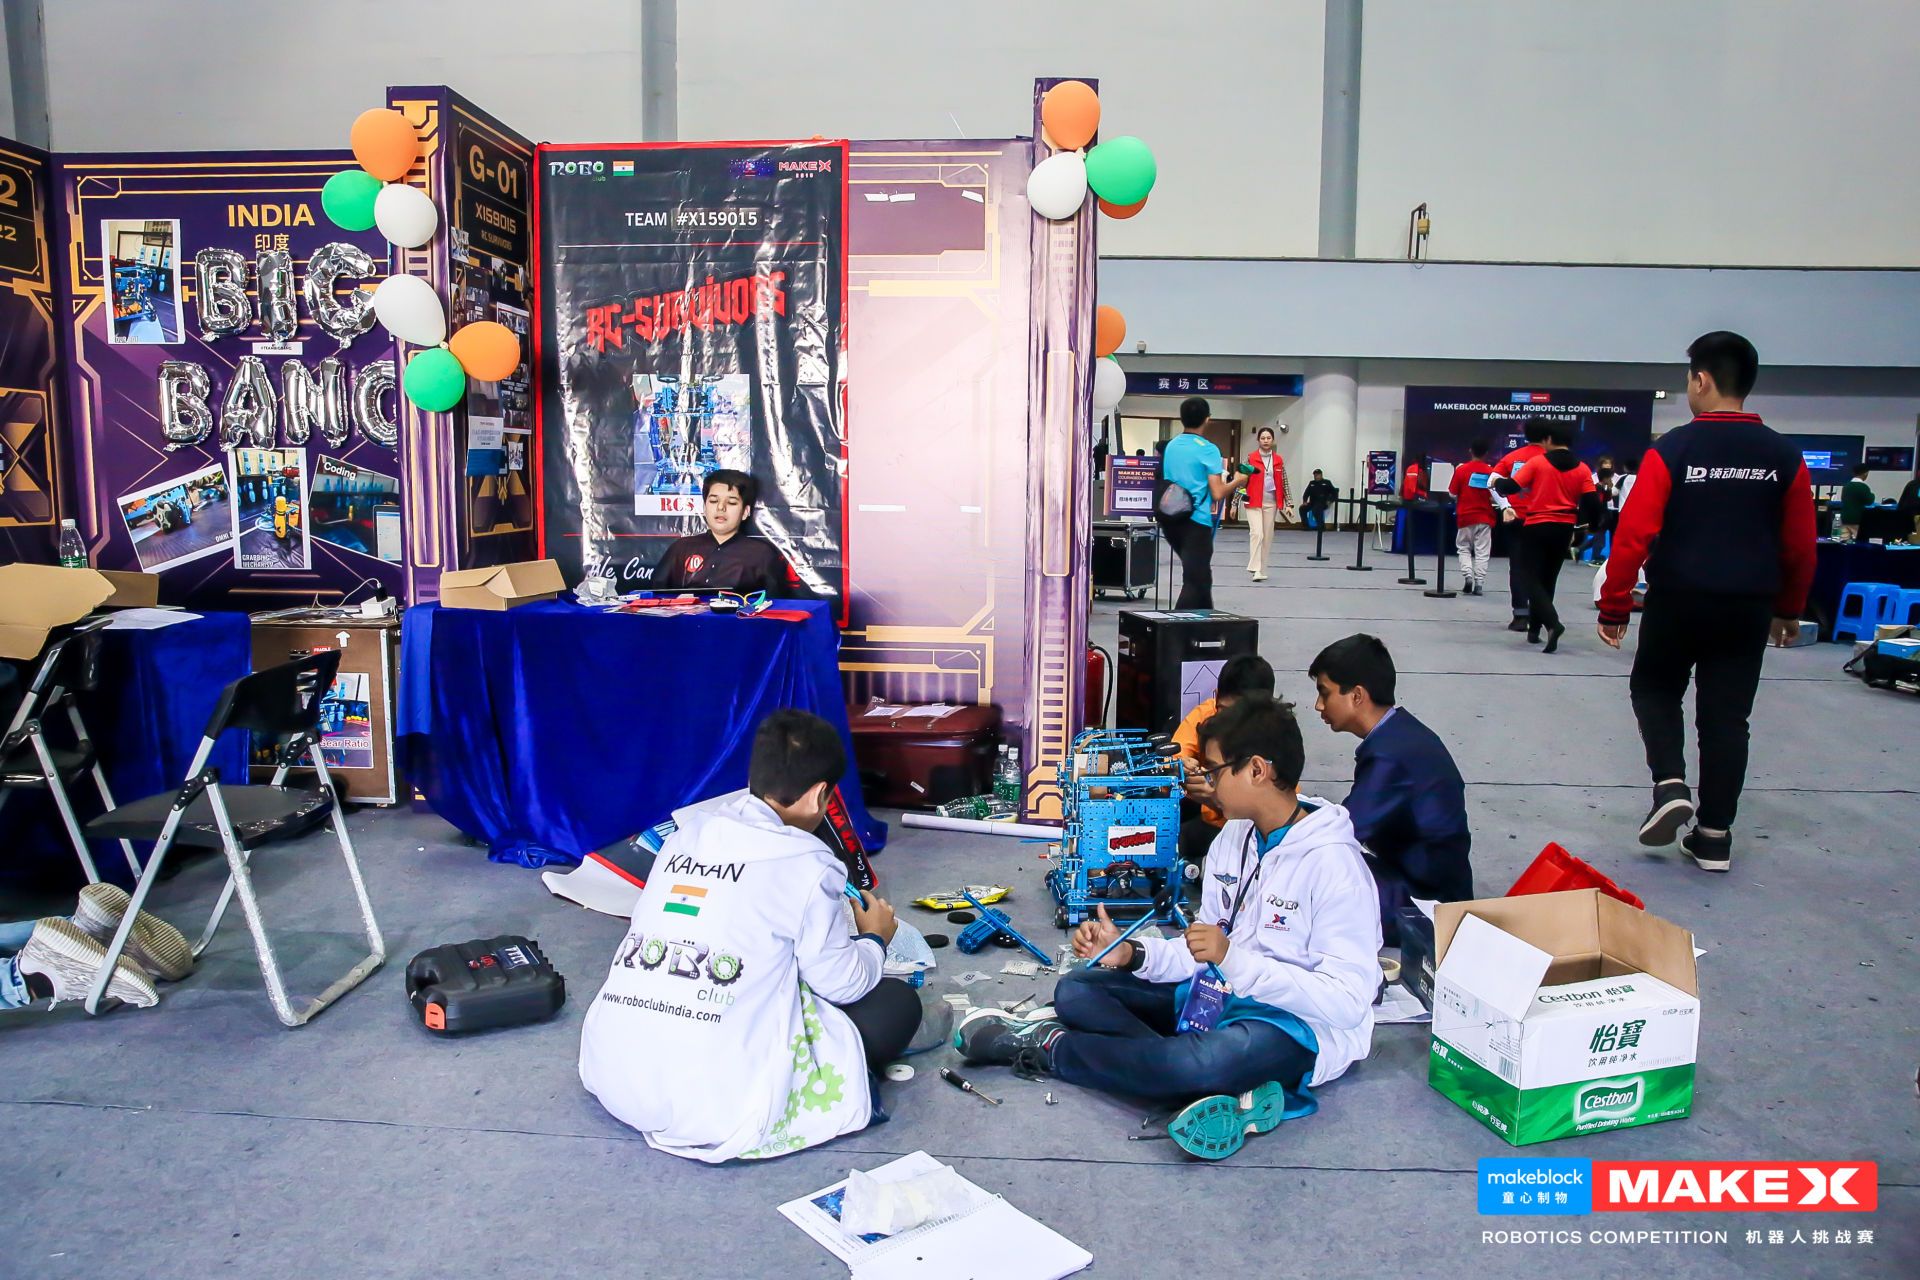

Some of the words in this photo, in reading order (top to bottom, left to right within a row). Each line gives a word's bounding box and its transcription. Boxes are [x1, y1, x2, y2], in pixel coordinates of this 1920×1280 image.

[468, 144, 518, 200] G-01
[548, 160, 605, 176] ROBO
[227, 203, 316, 228] INDIA
[625, 211, 668, 227] TEAM
[676, 211, 758, 226] #X159015
[254, 233, 290, 252] 印度
[194, 241, 378, 348] BIG
[1158, 378, 1209, 390] 赛场区
[1434, 402, 1488, 411] MAKEBLOCK
[1489, 403, 1521, 412] MAKEX
[1523, 404, 1566, 412] ROBOTICS
[1567, 405, 1627, 413] COMPETITION
[323, 460, 357, 481] Coding
[1709, 467, 1778, 482] 领动机器人
[623, 556, 656, 580] Can
[344, 738, 369, 748] Ratio
[664, 854, 746, 883] KARAN
[614, 932, 744, 987] ROBO
[697, 987, 736, 1007] club
[1604, 984, 1636, 997] 怡寶
[602, 991, 722, 1024] www.roboclubindia.com
[1588, 1018, 1647, 1054] 怡寶
[1587, 1051, 1639, 1068] 饮用纯净水
[1575, 1120, 1598, 1132] Purified
[1597, 1118, 1620, 1128] Drinking
[1619, 1116, 1637, 1125] Water
